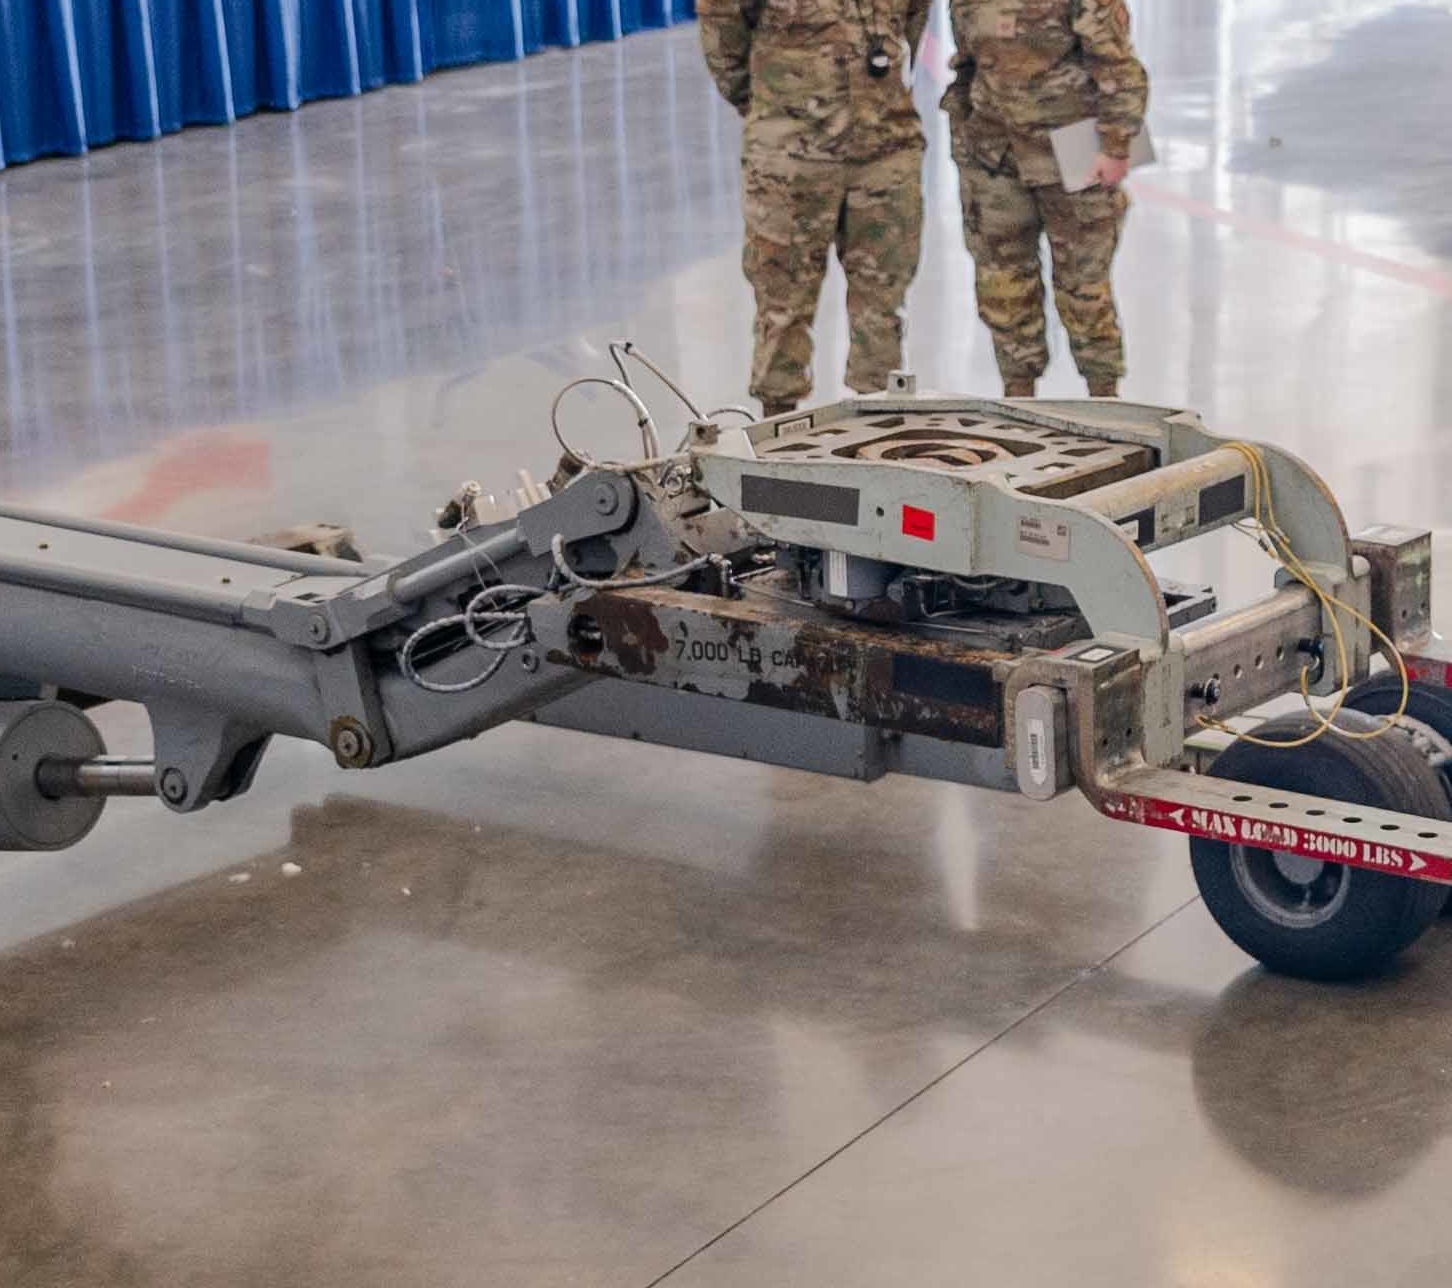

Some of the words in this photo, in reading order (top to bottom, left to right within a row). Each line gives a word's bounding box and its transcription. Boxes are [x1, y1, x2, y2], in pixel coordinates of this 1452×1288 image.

[1191, 808, 1237, 838] MAX
[1240, 819, 1299, 850] LOAD
[1303, 832, 1358, 860] 3000
[1362, 843, 1405, 869] LBS
